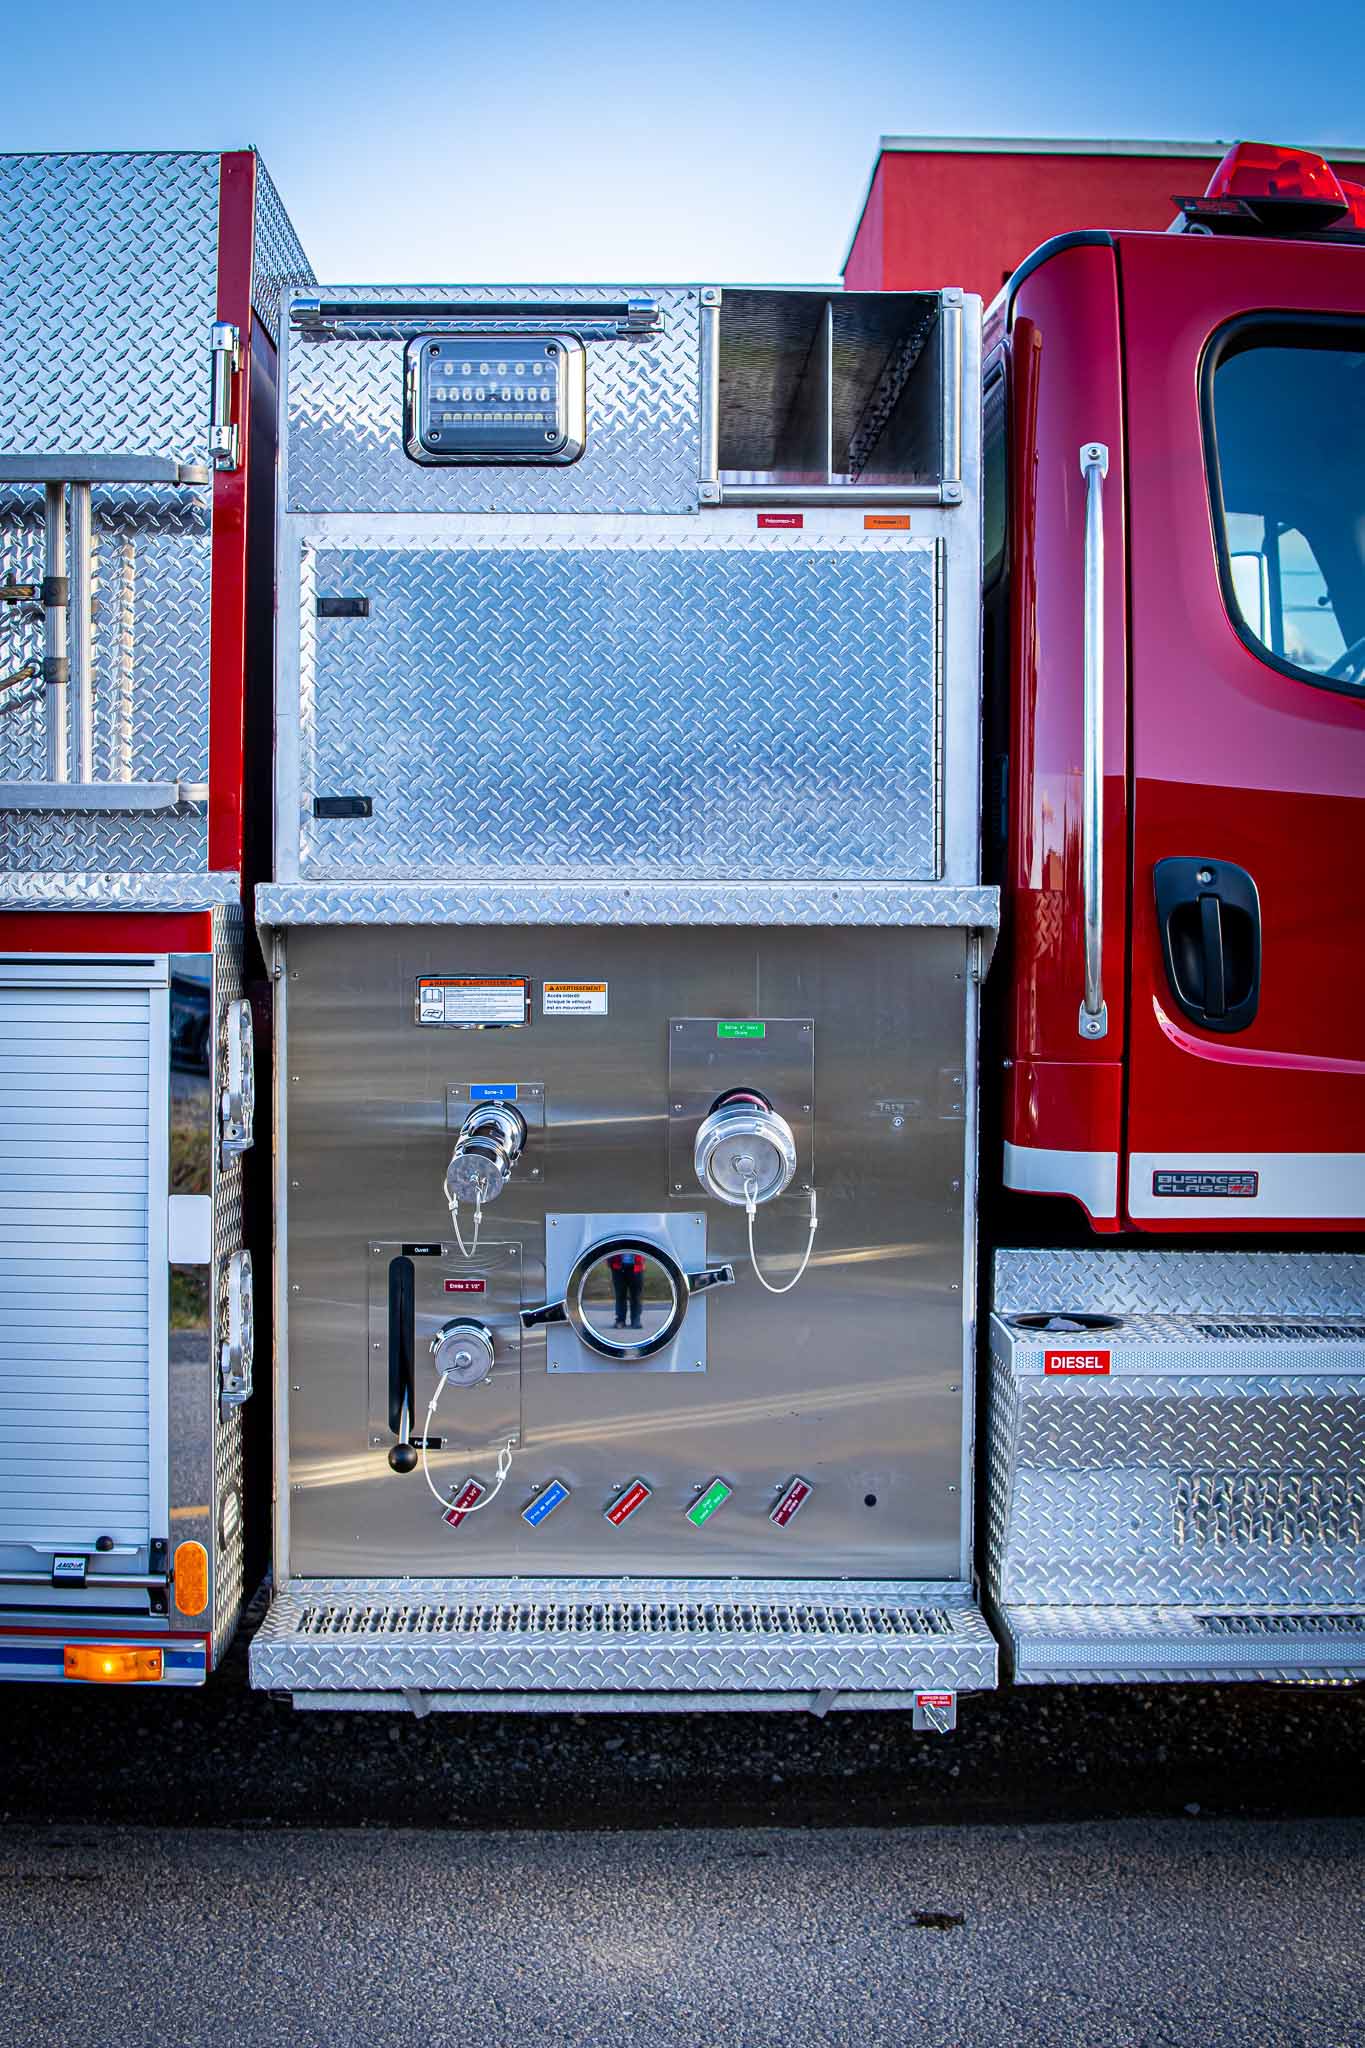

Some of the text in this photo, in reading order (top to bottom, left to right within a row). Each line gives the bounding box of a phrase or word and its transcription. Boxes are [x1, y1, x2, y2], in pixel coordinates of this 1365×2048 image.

[1158, 1175, 1255, 1184] BUSINESS
[1158, 1184, 1228, 1193] CLASS
[1050, 1356, 1105, 1369] DIESEL
